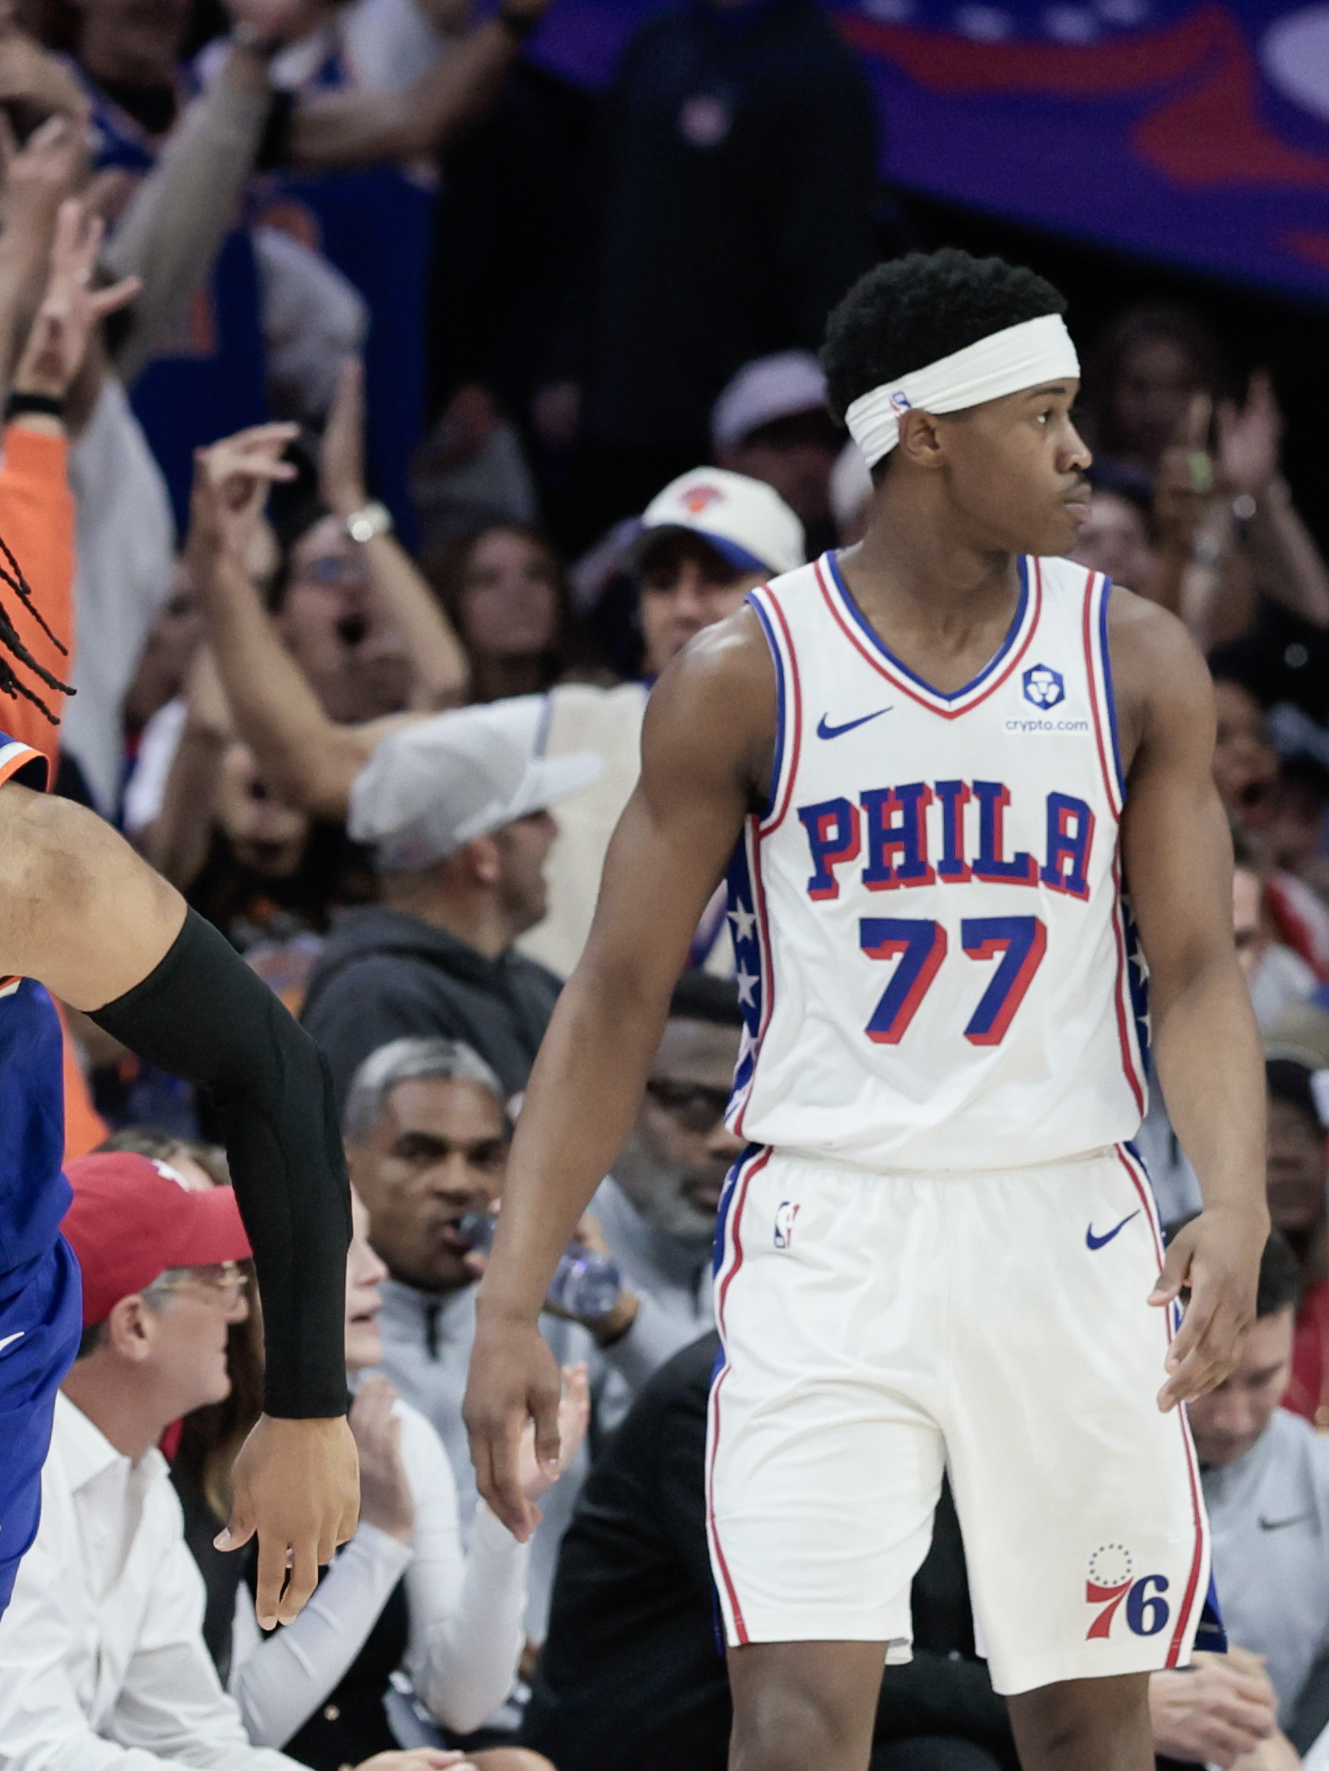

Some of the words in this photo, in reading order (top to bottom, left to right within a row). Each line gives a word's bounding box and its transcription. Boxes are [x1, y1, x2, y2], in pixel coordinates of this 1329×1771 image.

[1004, 719, 1089, 732] crypto.com
[797, 779, 1096, 903] PHILA
[858, 915, 1048, 1047] 77
[1084, 1573, 1170, 1642] 76
